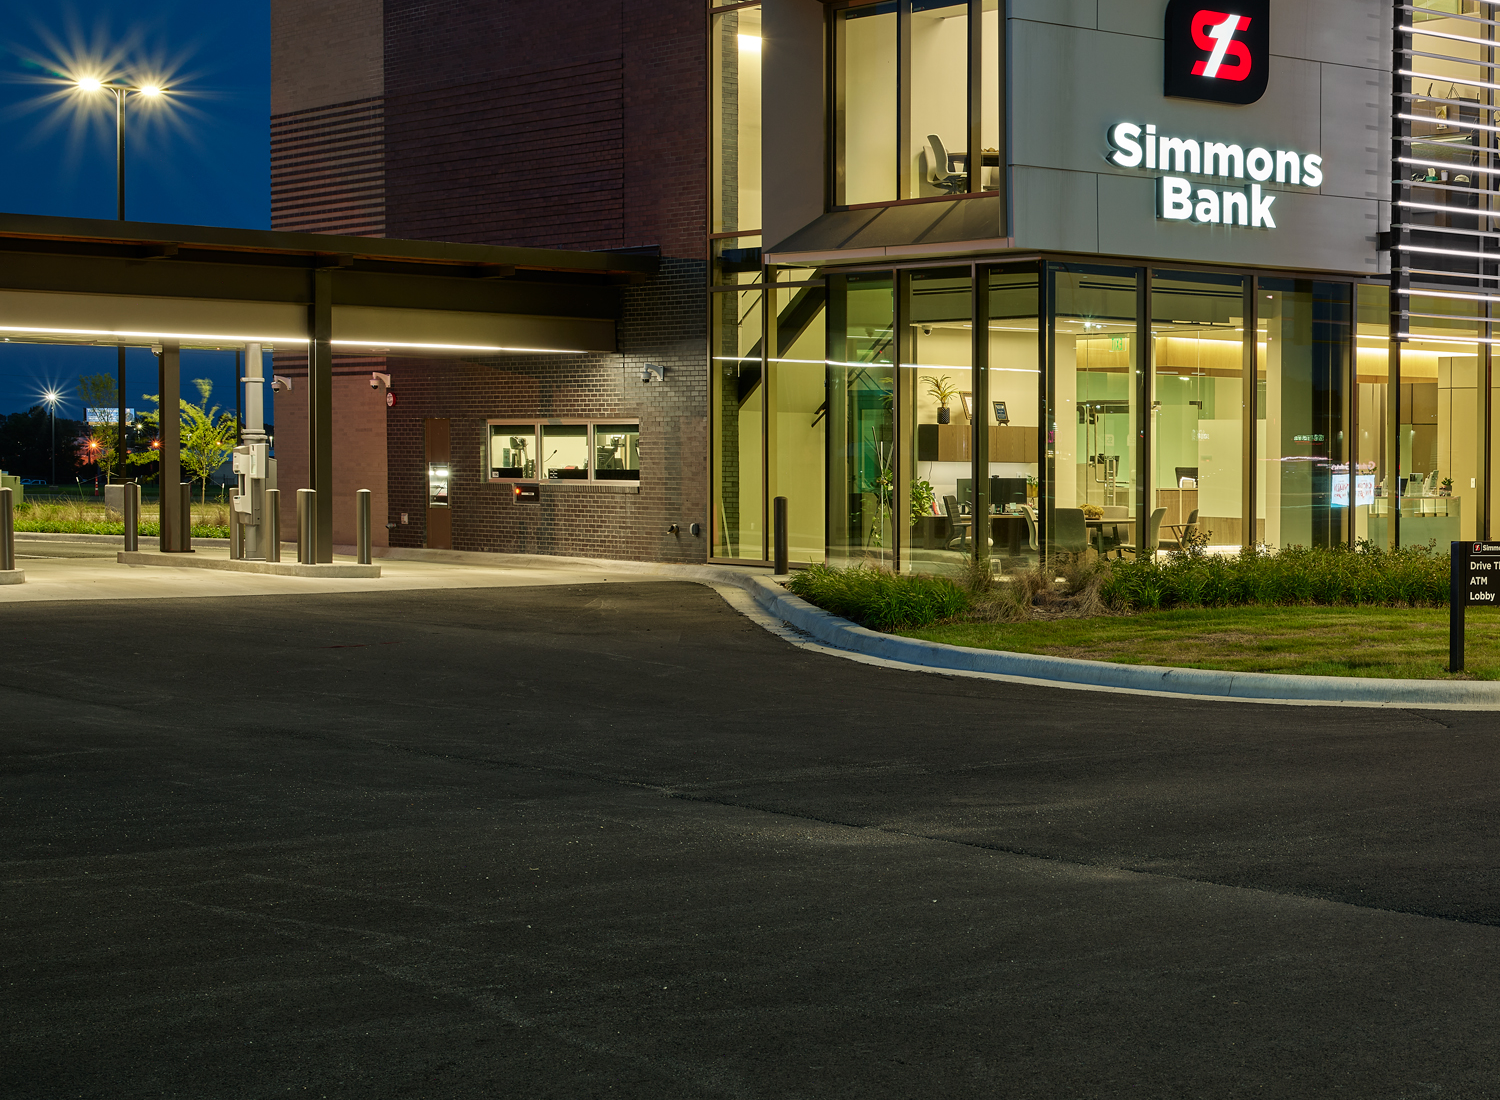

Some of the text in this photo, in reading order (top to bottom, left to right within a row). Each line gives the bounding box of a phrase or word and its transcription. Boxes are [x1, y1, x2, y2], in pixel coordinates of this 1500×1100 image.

[1110, 122, 1323, 188] Simmons
[1161, 176, 1277, 229] Bank
[1470, 561, 1492, 570] Drive
[1470, 576, 1488, 586] ATM
[1469, 591, 1496, 602] Lobby
